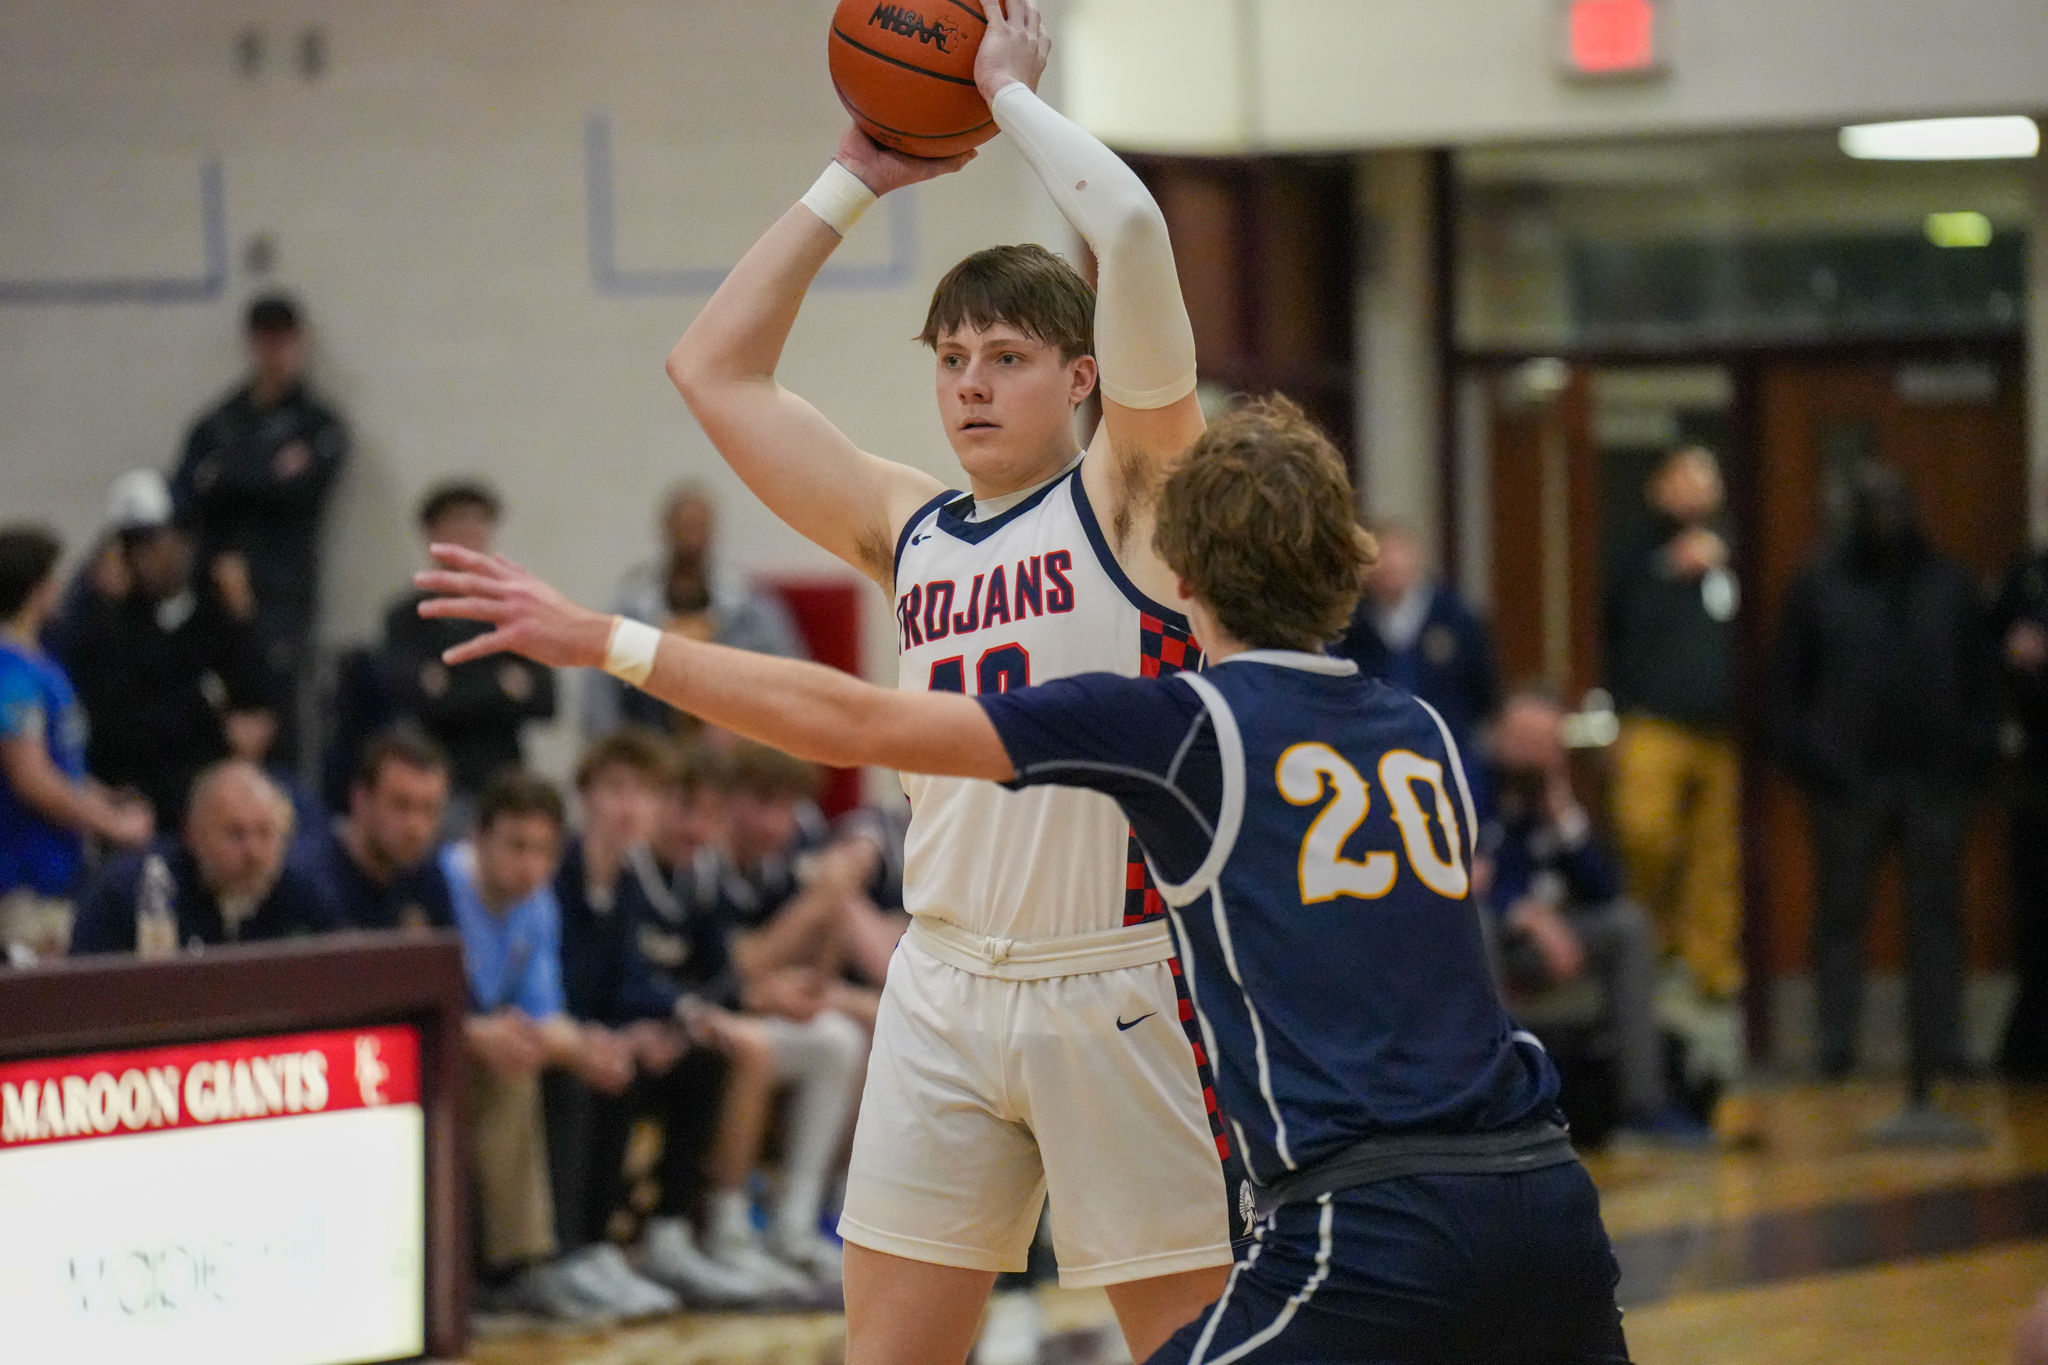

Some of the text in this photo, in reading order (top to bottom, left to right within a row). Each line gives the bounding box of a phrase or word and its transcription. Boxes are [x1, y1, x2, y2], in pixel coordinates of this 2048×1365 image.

[1275, 741, 1469, 905] 20
[1, 1064, 181, 1142] MAROON
[184, 1050, 329, 1122] GIANTS
